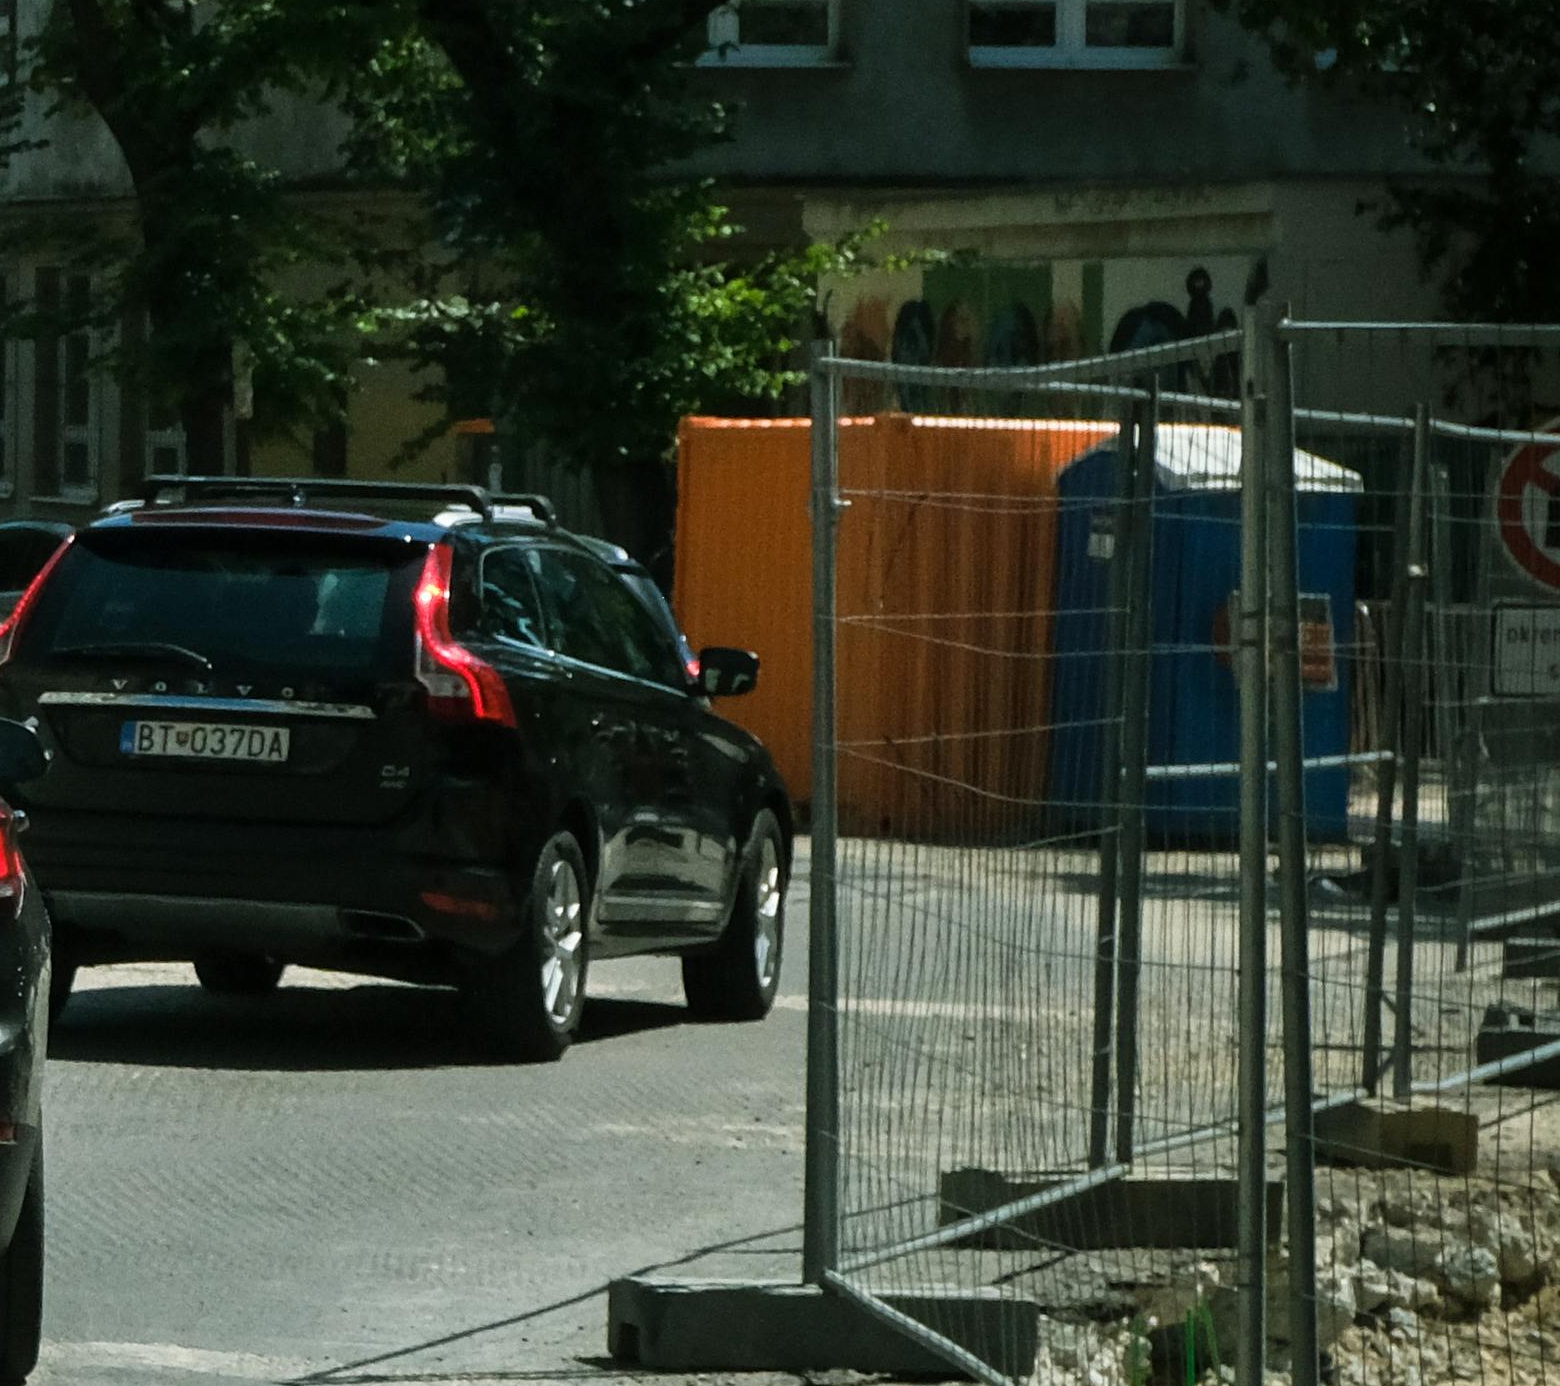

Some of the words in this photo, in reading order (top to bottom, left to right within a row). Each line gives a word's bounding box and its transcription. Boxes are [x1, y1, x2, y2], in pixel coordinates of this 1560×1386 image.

[111, 678, 295, 698] VOLVO
[138, 724, 176, 751] BT
[190, 728, 283, 758] 037DA
